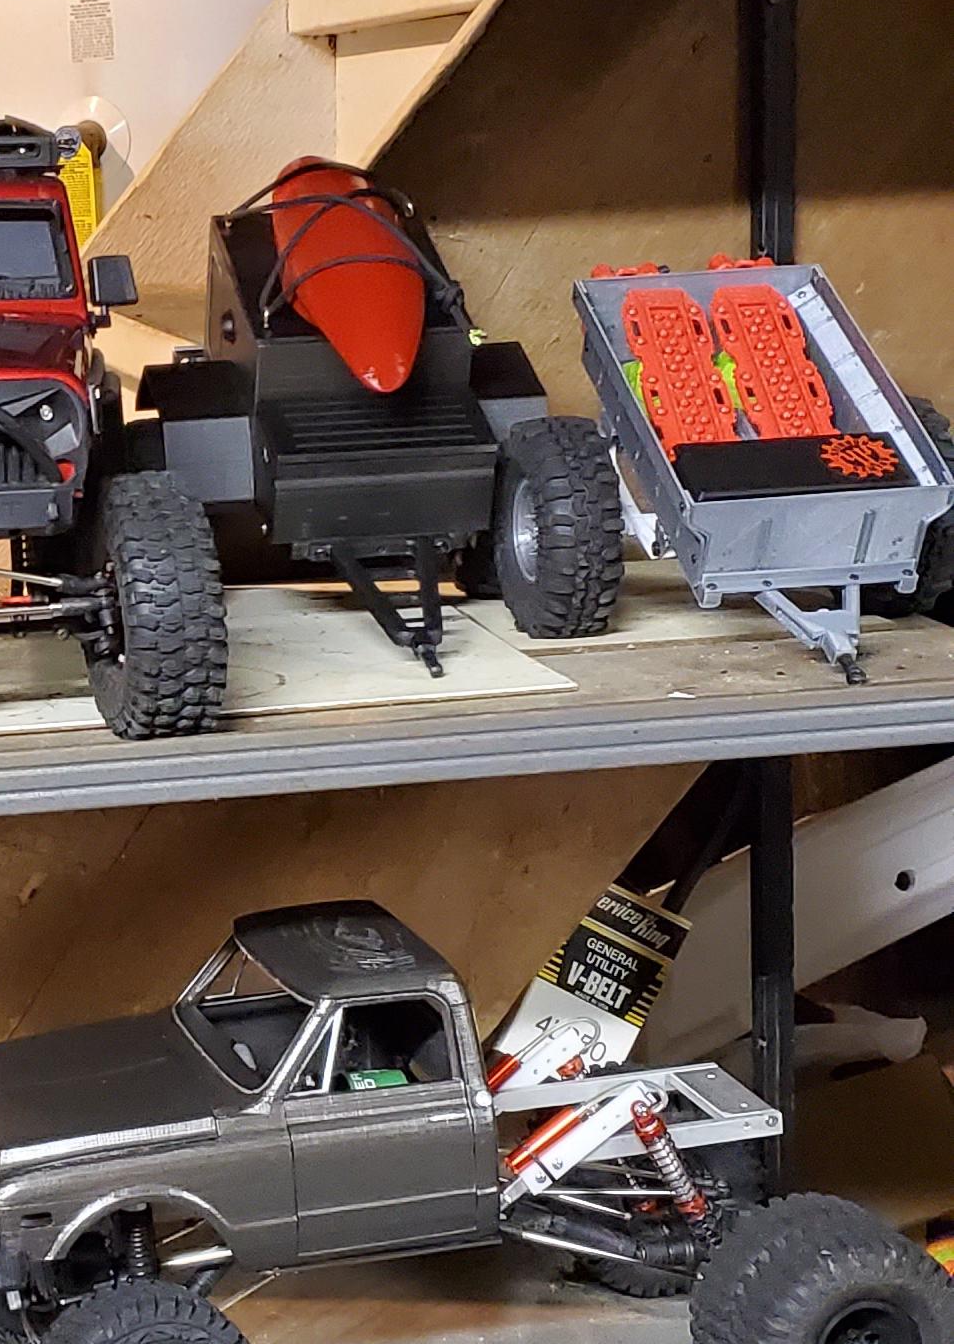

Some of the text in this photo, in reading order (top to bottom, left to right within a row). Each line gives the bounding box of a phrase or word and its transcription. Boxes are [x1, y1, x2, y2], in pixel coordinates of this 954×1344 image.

[596, 895, 644, 925] ervice
[586, 937, 639, 972] GENERAL
[586, 952, 630, 981] UTILITY
[566, 961, 632, 1009] V-BELT
